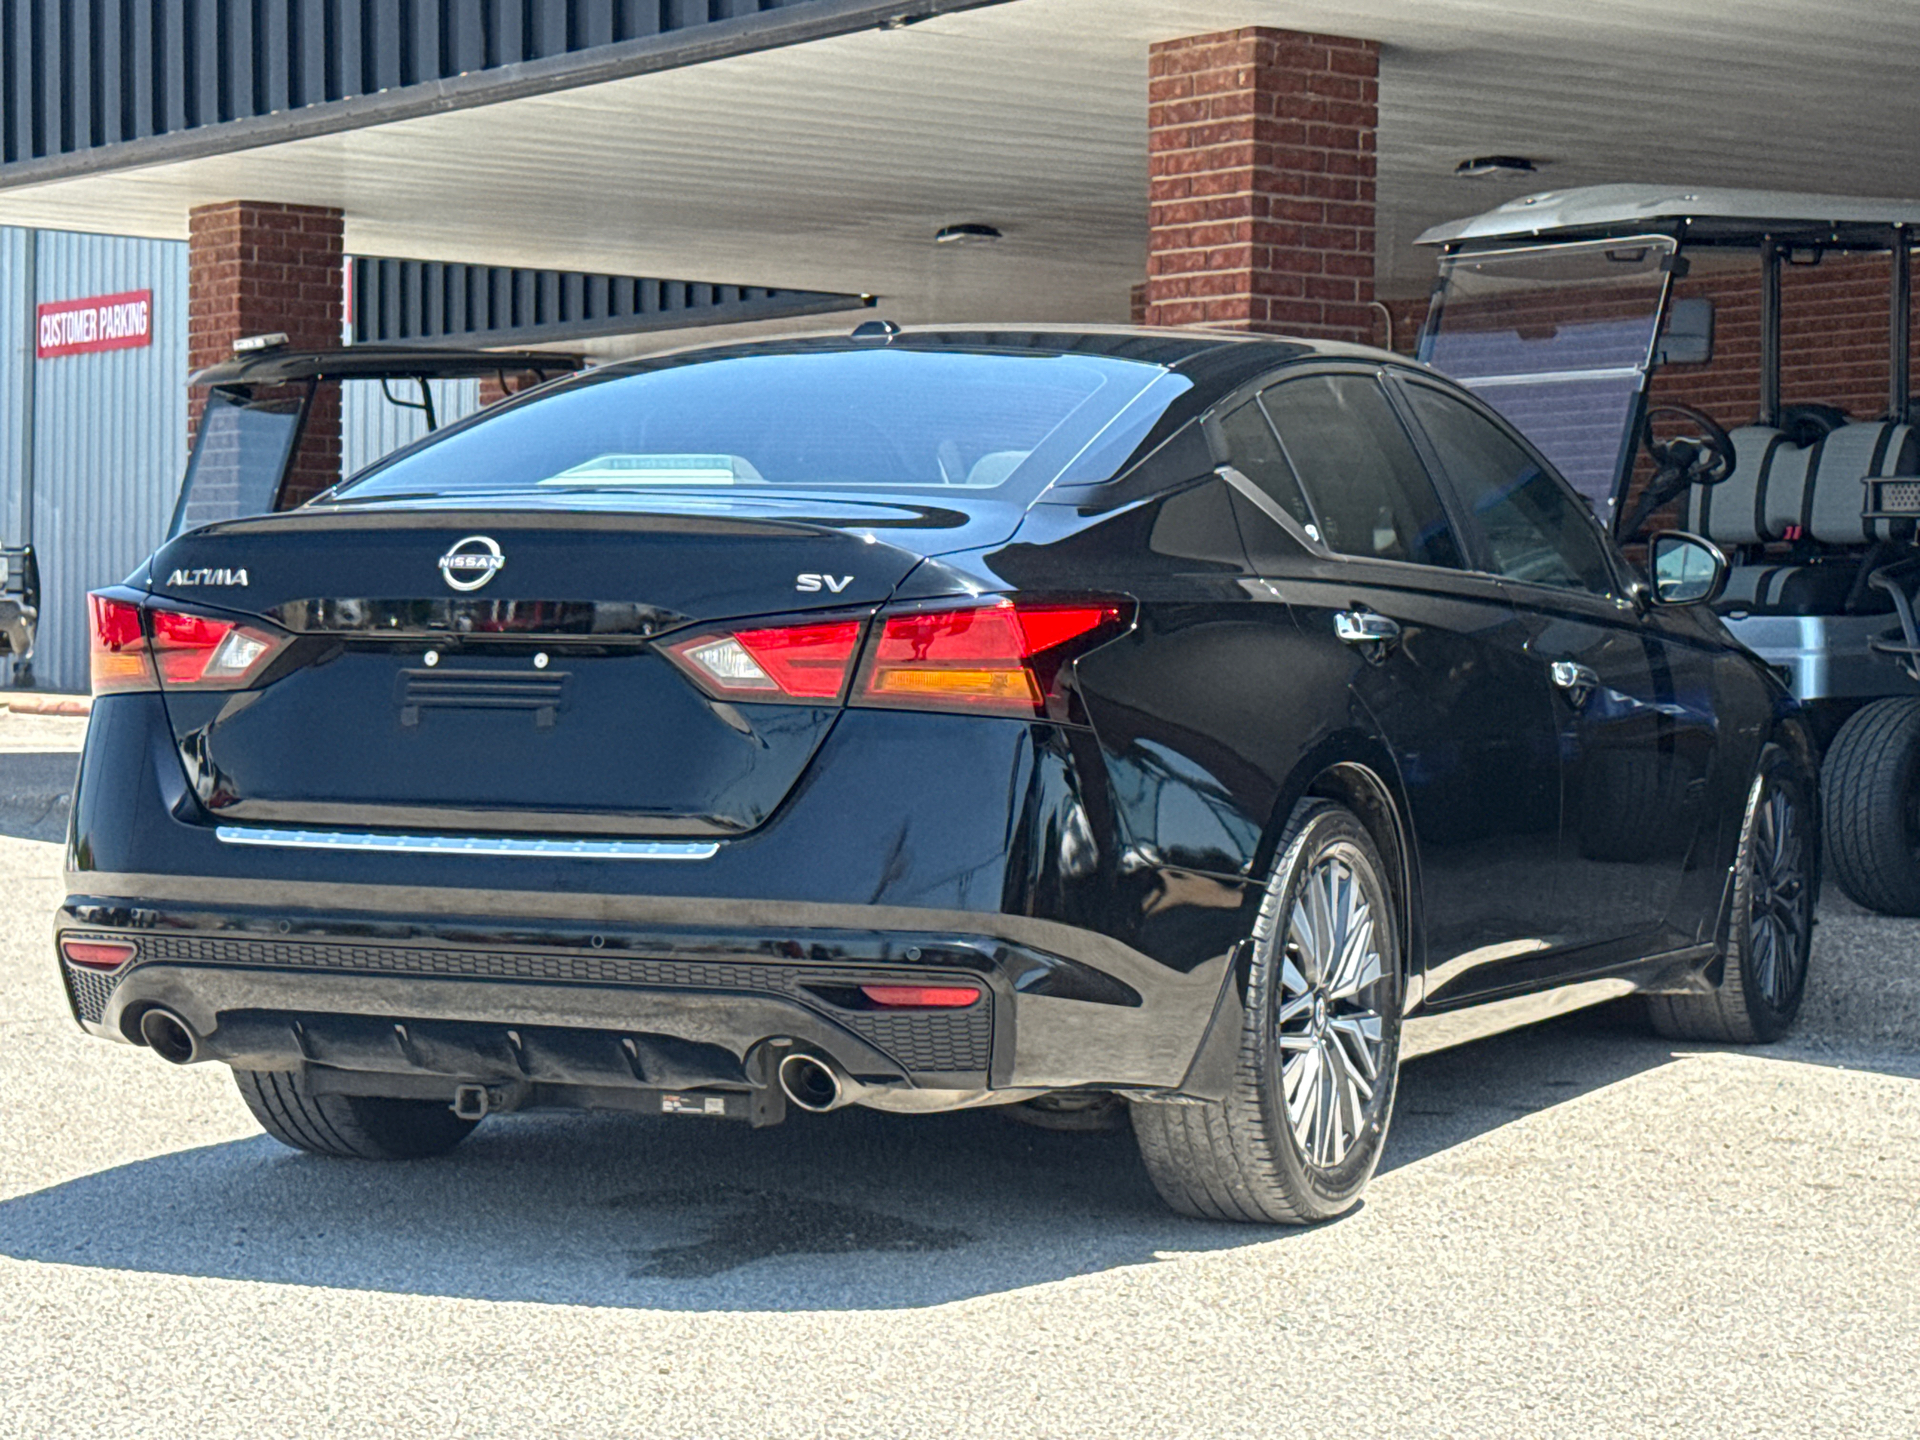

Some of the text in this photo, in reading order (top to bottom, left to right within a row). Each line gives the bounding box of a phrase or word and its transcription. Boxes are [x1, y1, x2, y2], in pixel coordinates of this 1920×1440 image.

[40, 300, 147, 348] CUSTOMER PARKING
[438, 555, 504, 569] NISSAN
[166, 568, 248, 586] ALTIMA
[796, 573, 854, 593] SV
